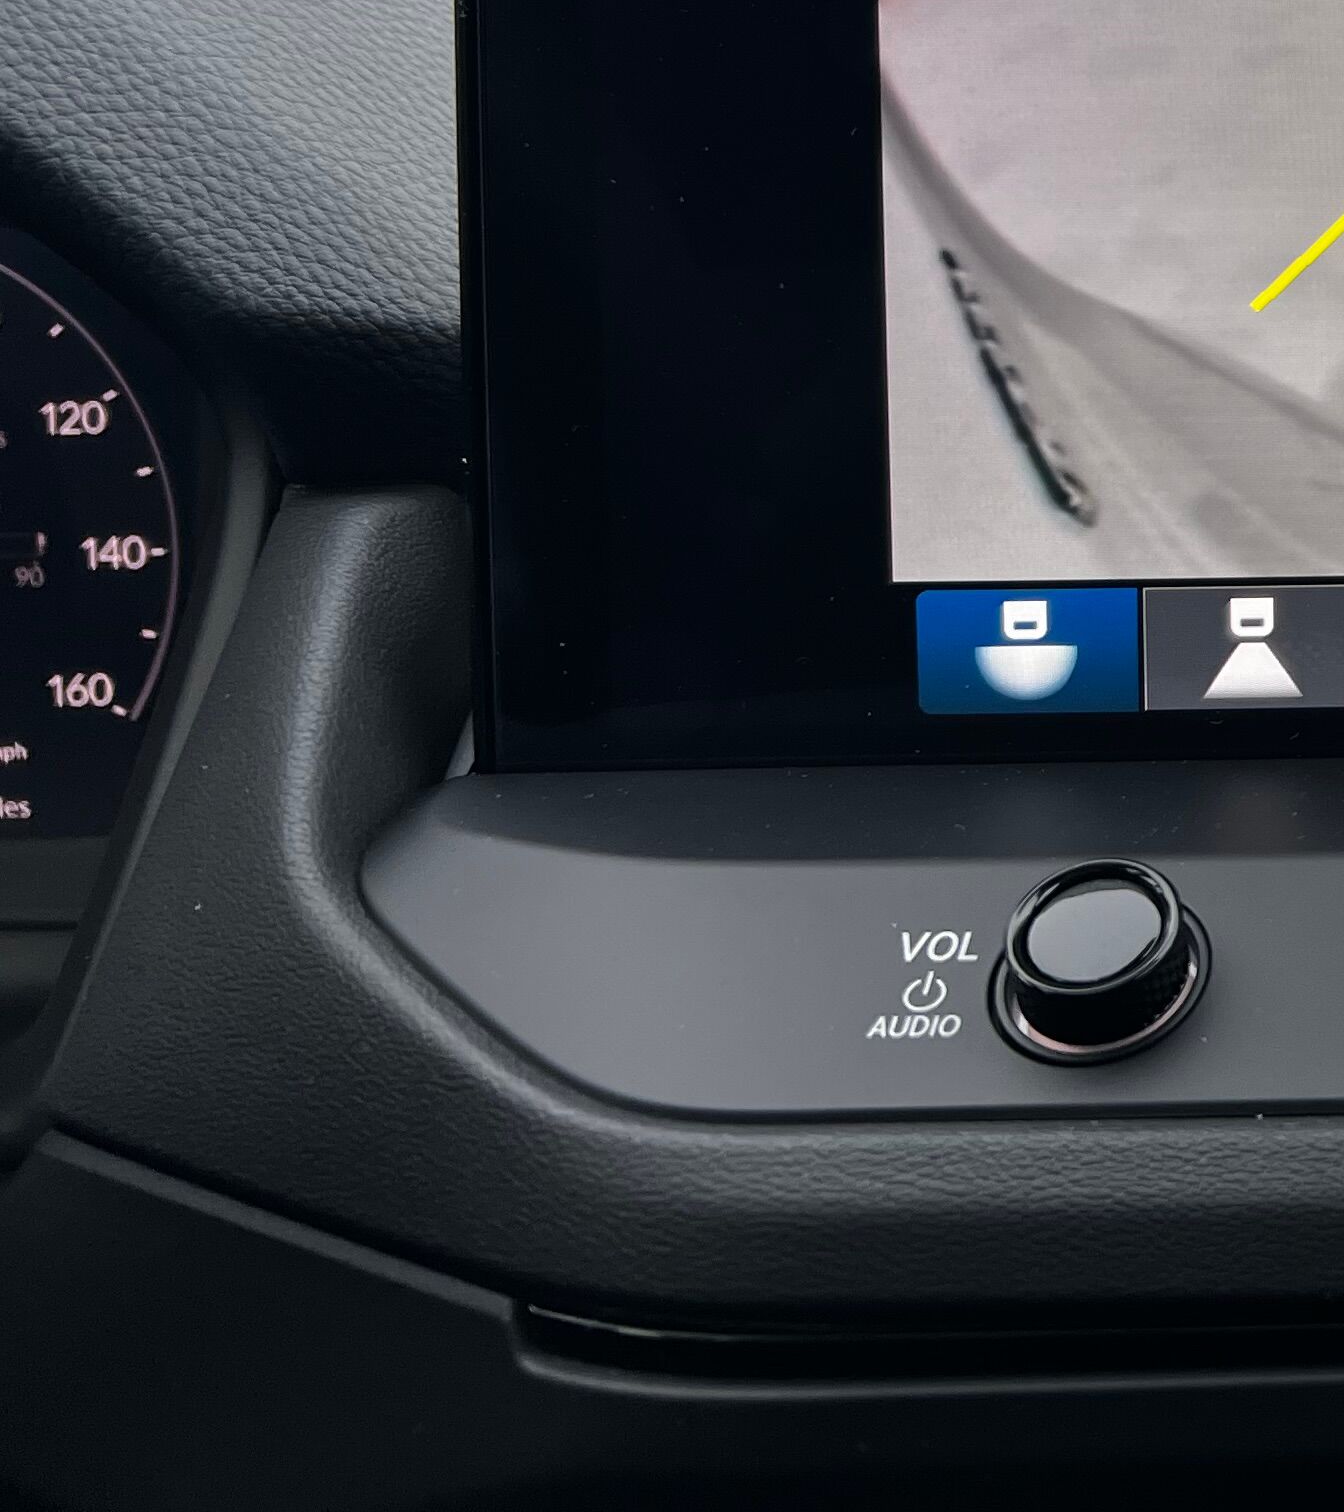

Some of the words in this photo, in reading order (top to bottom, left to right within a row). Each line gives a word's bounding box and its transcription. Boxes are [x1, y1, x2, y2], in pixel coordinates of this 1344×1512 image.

[38, 400, 107, 437] 120
[80, 534, 148, 572] 140
[46, 672, 114, 708] 160
[900, 930, 979, 963] VOL
[865, 1014, 962, 1040] AUDIO
